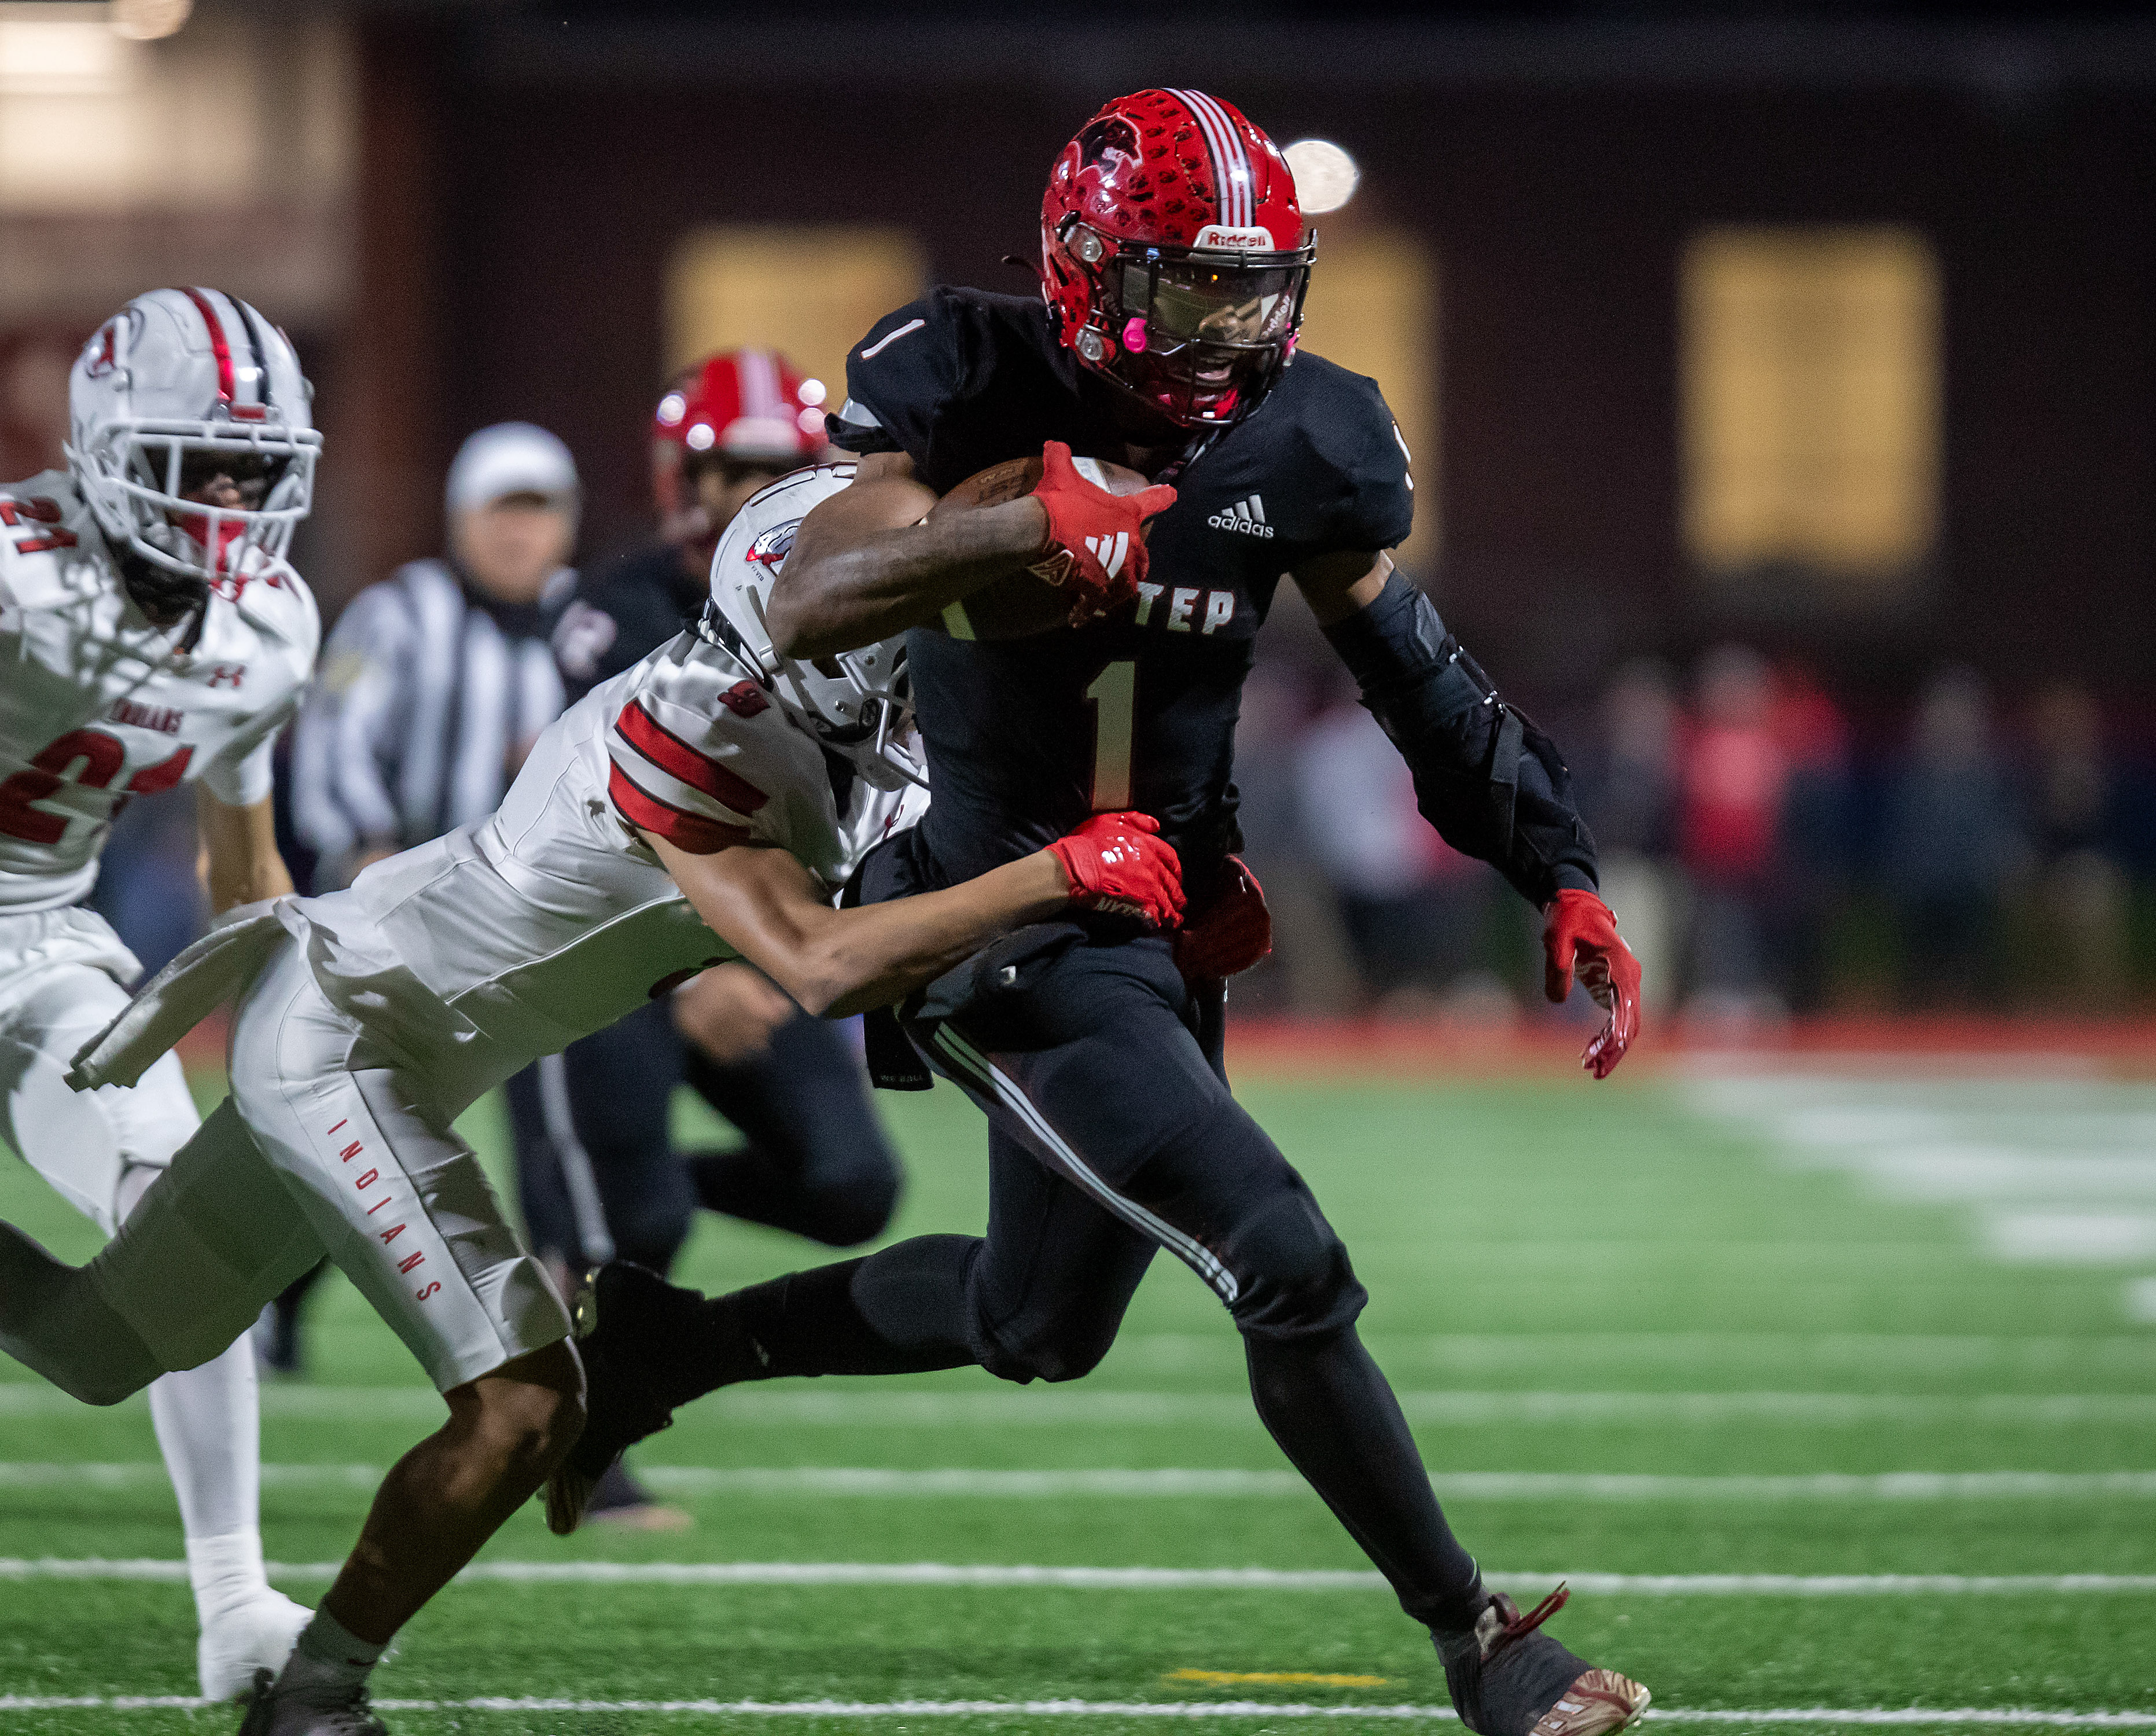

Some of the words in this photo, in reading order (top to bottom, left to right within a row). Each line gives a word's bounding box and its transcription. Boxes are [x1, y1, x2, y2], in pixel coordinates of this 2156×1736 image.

[1207, 516, 1274, 538] adidas
[1086, 660, 1136, 810] 1
[327, 1118, 441, 1301] INDIANS
